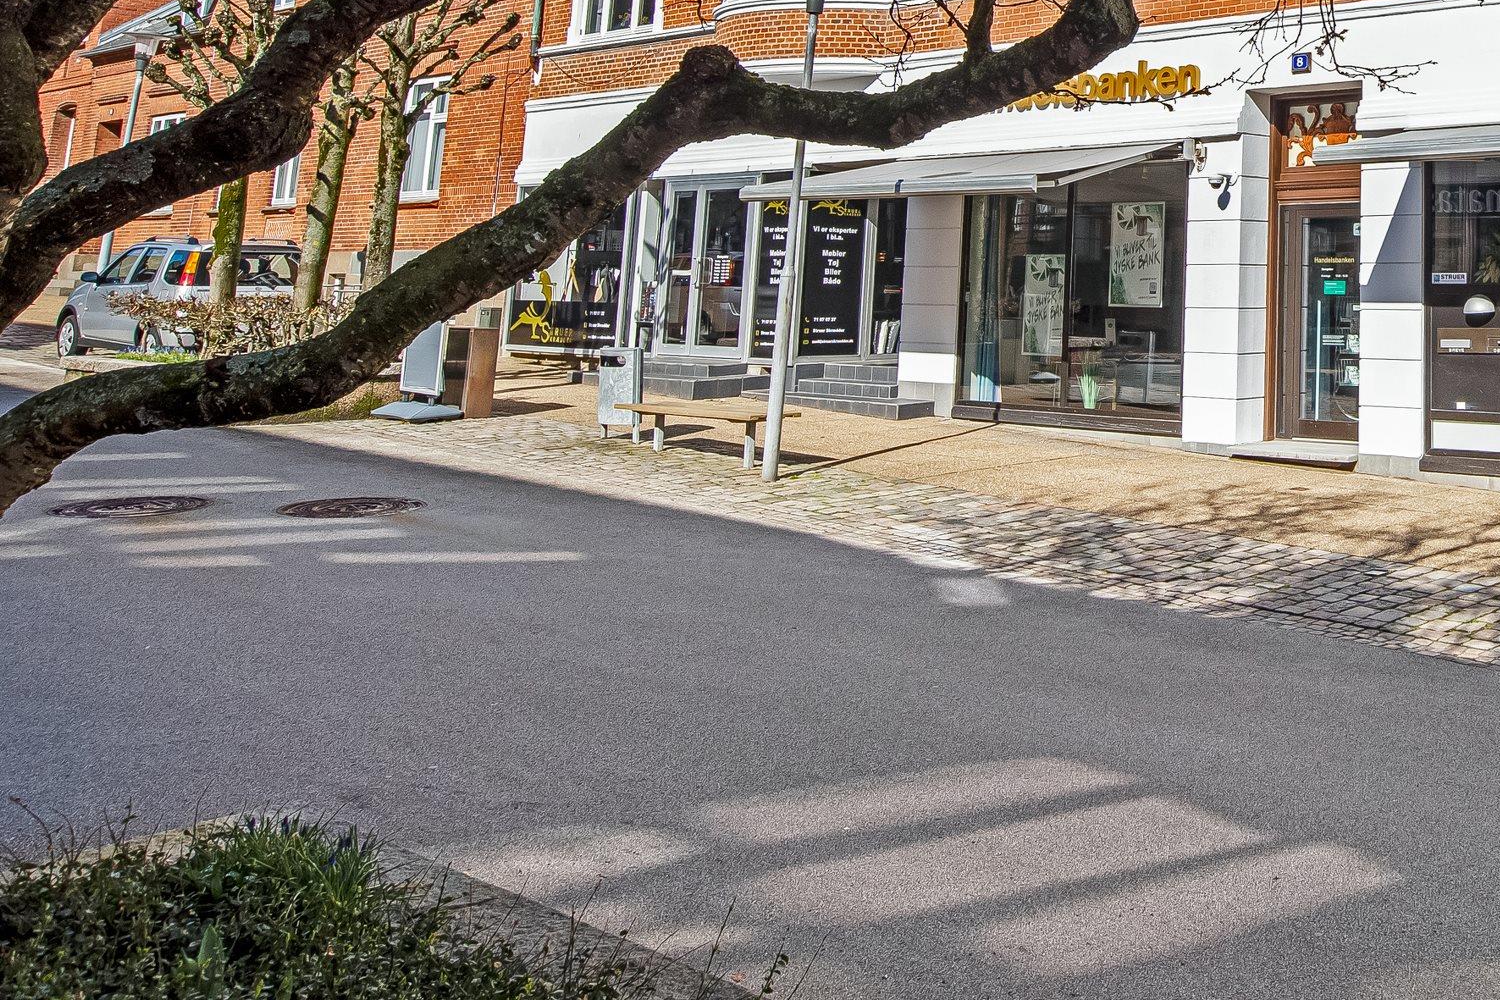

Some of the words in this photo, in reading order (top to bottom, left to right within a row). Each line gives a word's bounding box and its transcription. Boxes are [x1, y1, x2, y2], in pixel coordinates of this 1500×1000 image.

[1296, 57, 1304, 67] 8
[829, 226, 858, 234] eksperter
[1123, 238, 1146, 257] BLIVER
[1146, 233, 1157, 250] TIL
[1113, 255, 1136, 275] JYSKE
[1138, 250, 1161, 271] BANK
[823, 277, 841, 285] Både
[1027, 305, 1048, 325] JYSKE
[1050, 304, 1064, 320] BAN
